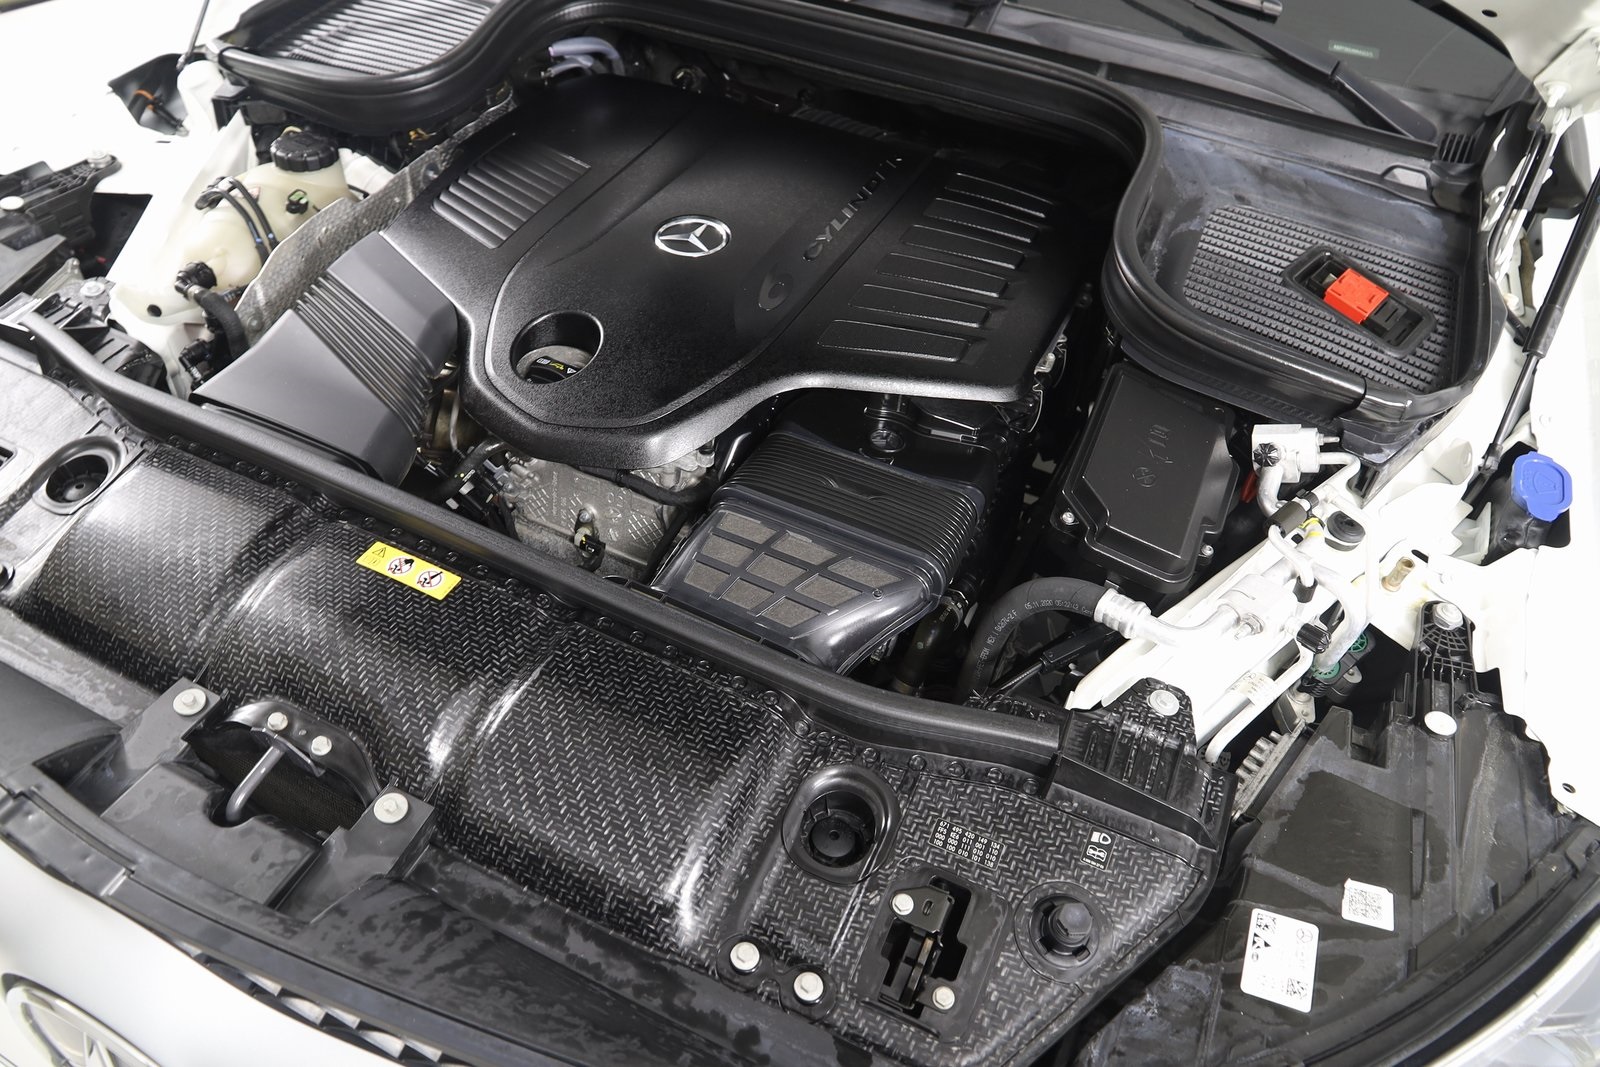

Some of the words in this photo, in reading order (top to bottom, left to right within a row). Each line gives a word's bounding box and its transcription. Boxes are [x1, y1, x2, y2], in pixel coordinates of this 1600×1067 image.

[801, 155, 904, 261] CYLIND
[935, 832, 946, 841] 000
[947, 837, 958, 846] 000
[961, 843, 970, 851] 111
[972, 848, 983, 856] 010
[985, 853, 996, 862] 010
[939, 821, 950, 829] 671
[952, 826, 962, 834] 495
[965, 831, 975, 839] 420
[991, 841, 1000, 849] 134
[962, 837, 973, 845] 011
[975, 842, 985, 850] 001
[989, 847, 998, 856] 110
[933, 838, 943, 847] 100
[946, 844, 956, 852] 100
[958, 849, 968, 857] 010
[971, 854, 981, 862] 101
